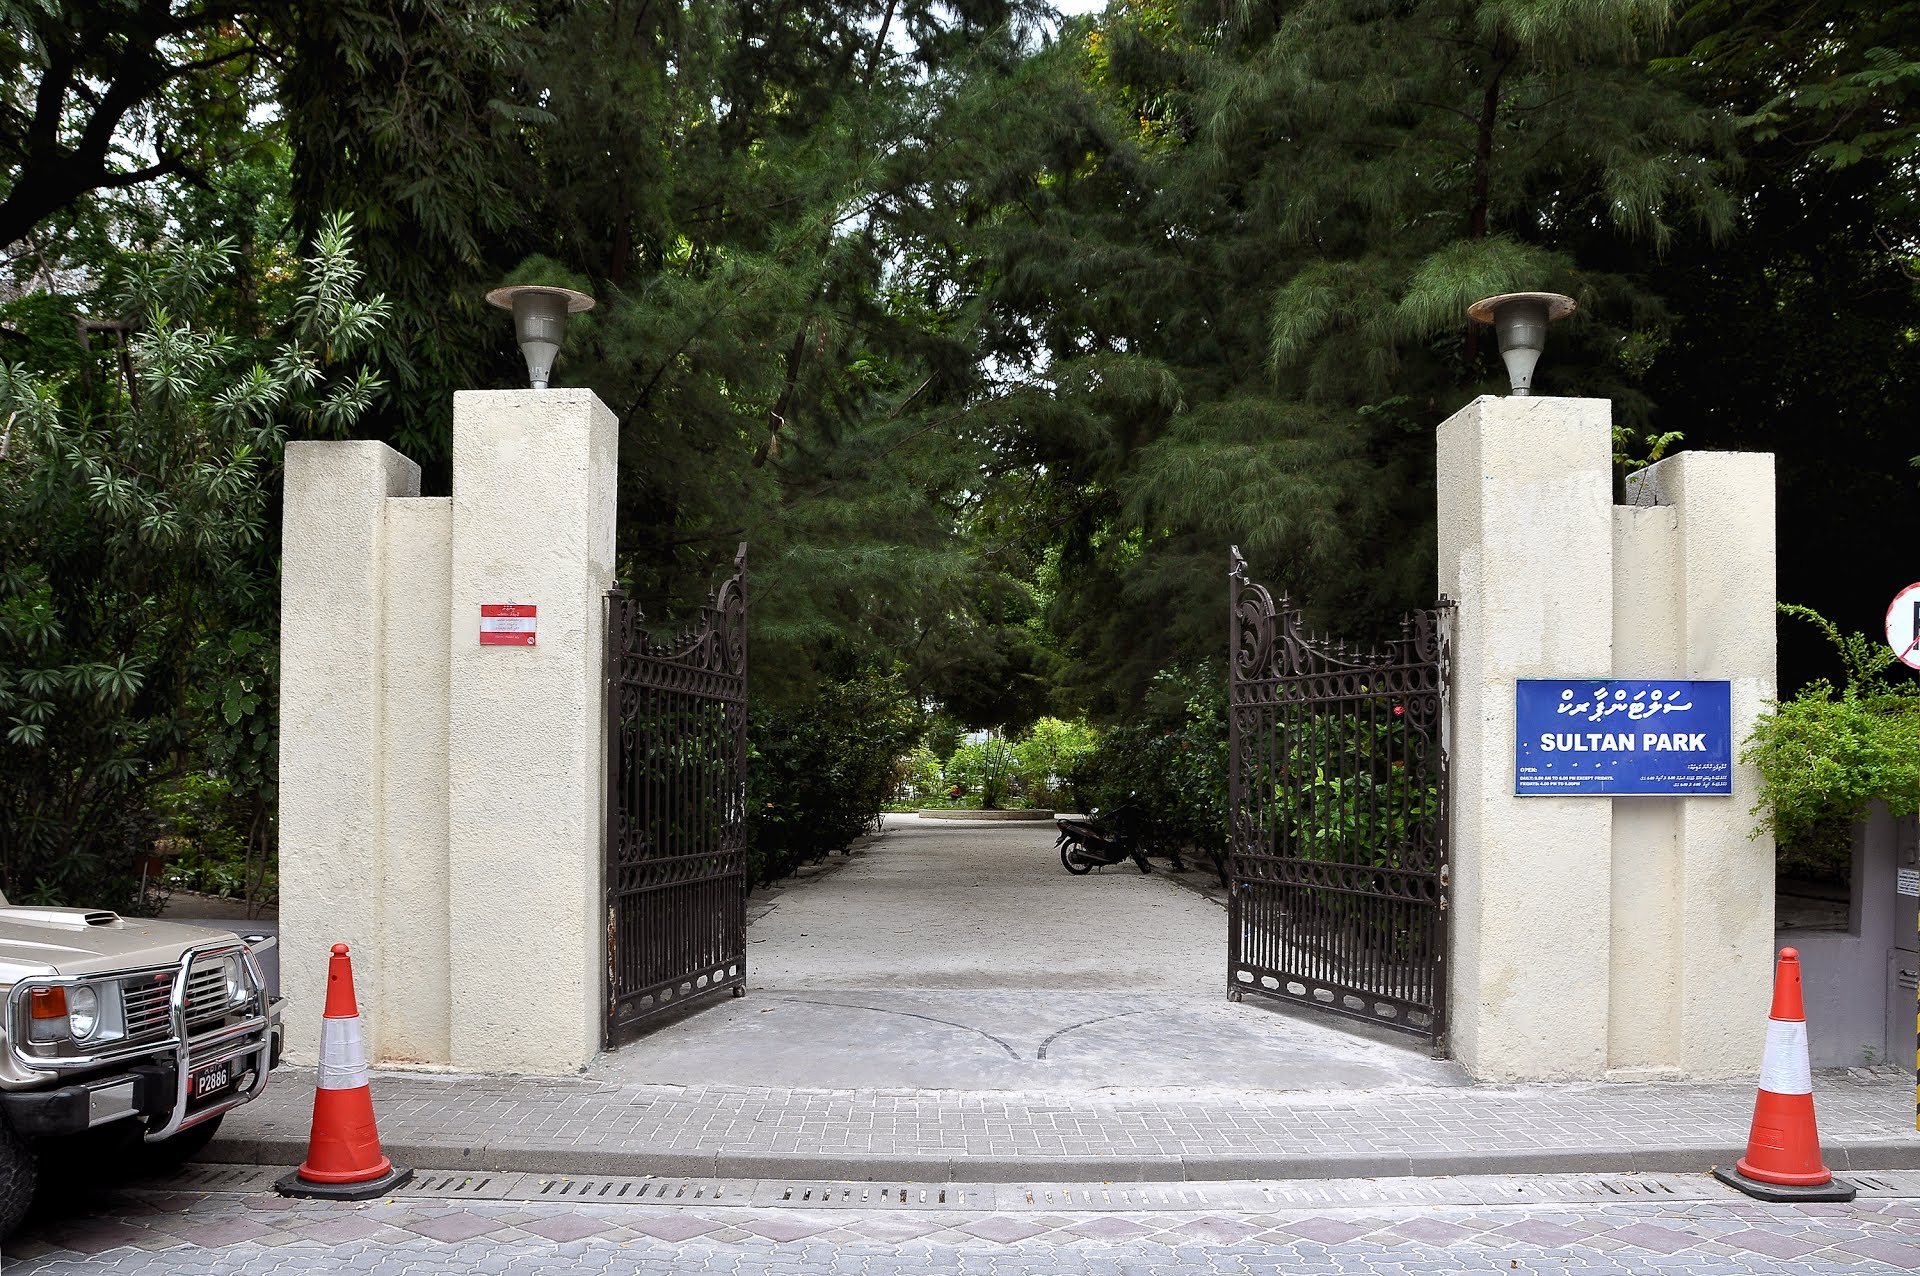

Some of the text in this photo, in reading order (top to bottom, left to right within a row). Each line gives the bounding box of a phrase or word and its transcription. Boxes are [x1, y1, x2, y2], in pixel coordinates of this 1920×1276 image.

[1540, 733, 1707, 752] SULTAN PARK
[198, 1069, 227, 1094] P2886
